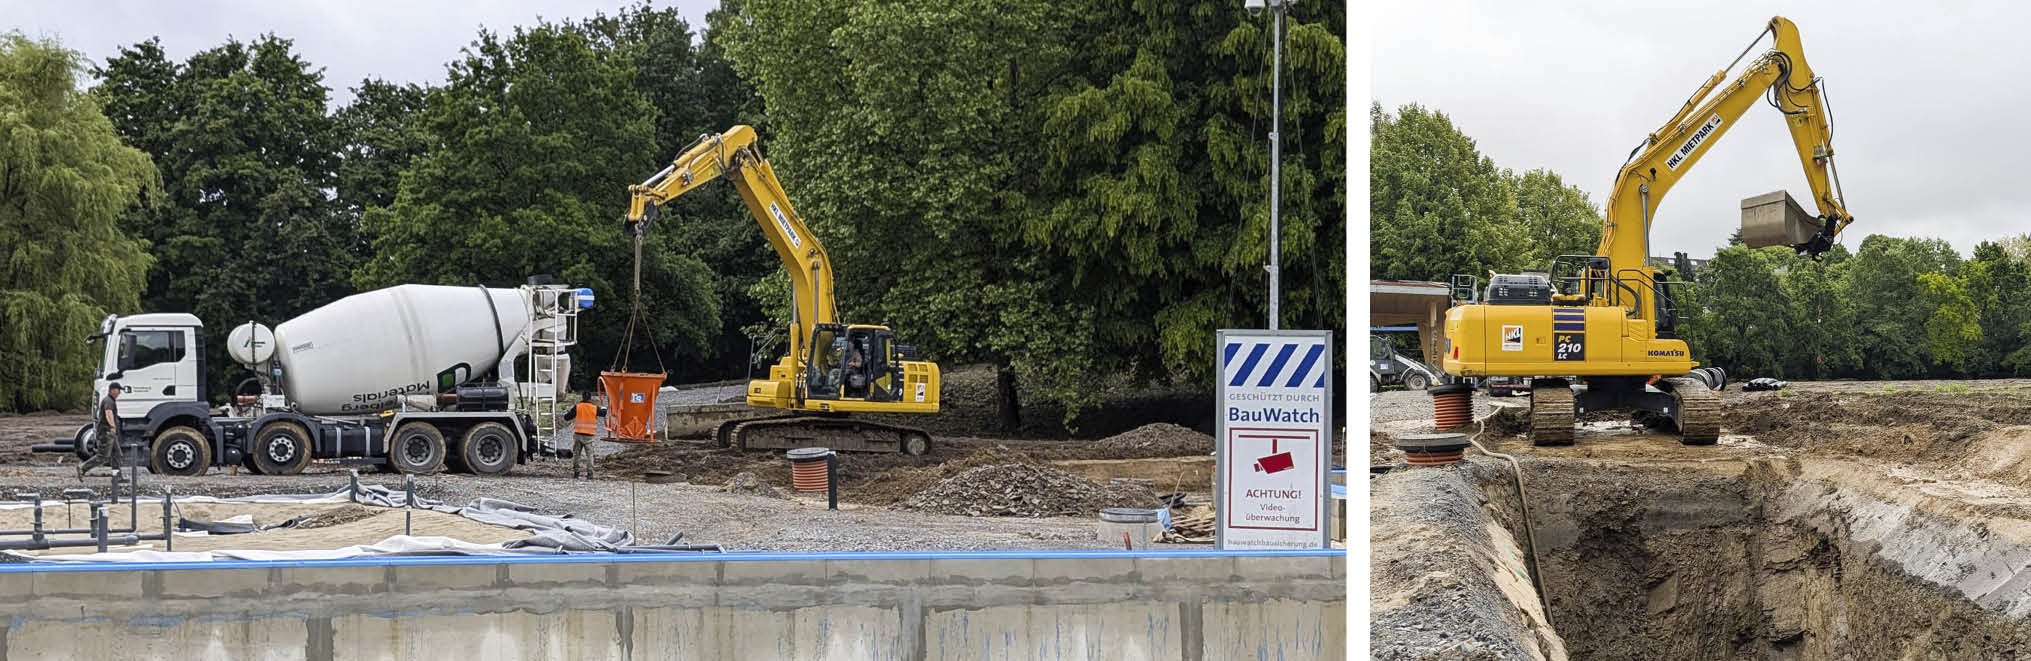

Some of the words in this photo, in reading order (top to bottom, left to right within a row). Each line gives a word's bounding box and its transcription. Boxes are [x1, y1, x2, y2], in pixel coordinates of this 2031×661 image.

[1667, 153, 1683, 168] HKL
[1680, 122, 1714, 155] MIETPARK
[1505, 328, 1520, 341] HKL
[1559, 335, 1571, 343] PC
[1557, 343, 1581, 353] 210
[1647, 349, 1685, 357] KOMATSU
[353, 380, 430, 402] Materials
[1229, 392, 1283, 401] GESCHÜTZT
[1286, 394, 1320, 402] DURCH
[1229, 407, 1320, 423] BauWatch
[1246, 489, 1302, 500] ACHTUNG!
[1260, 503, 1286, 512] Video-
[1246, 513, 1300, 524] überwachung
